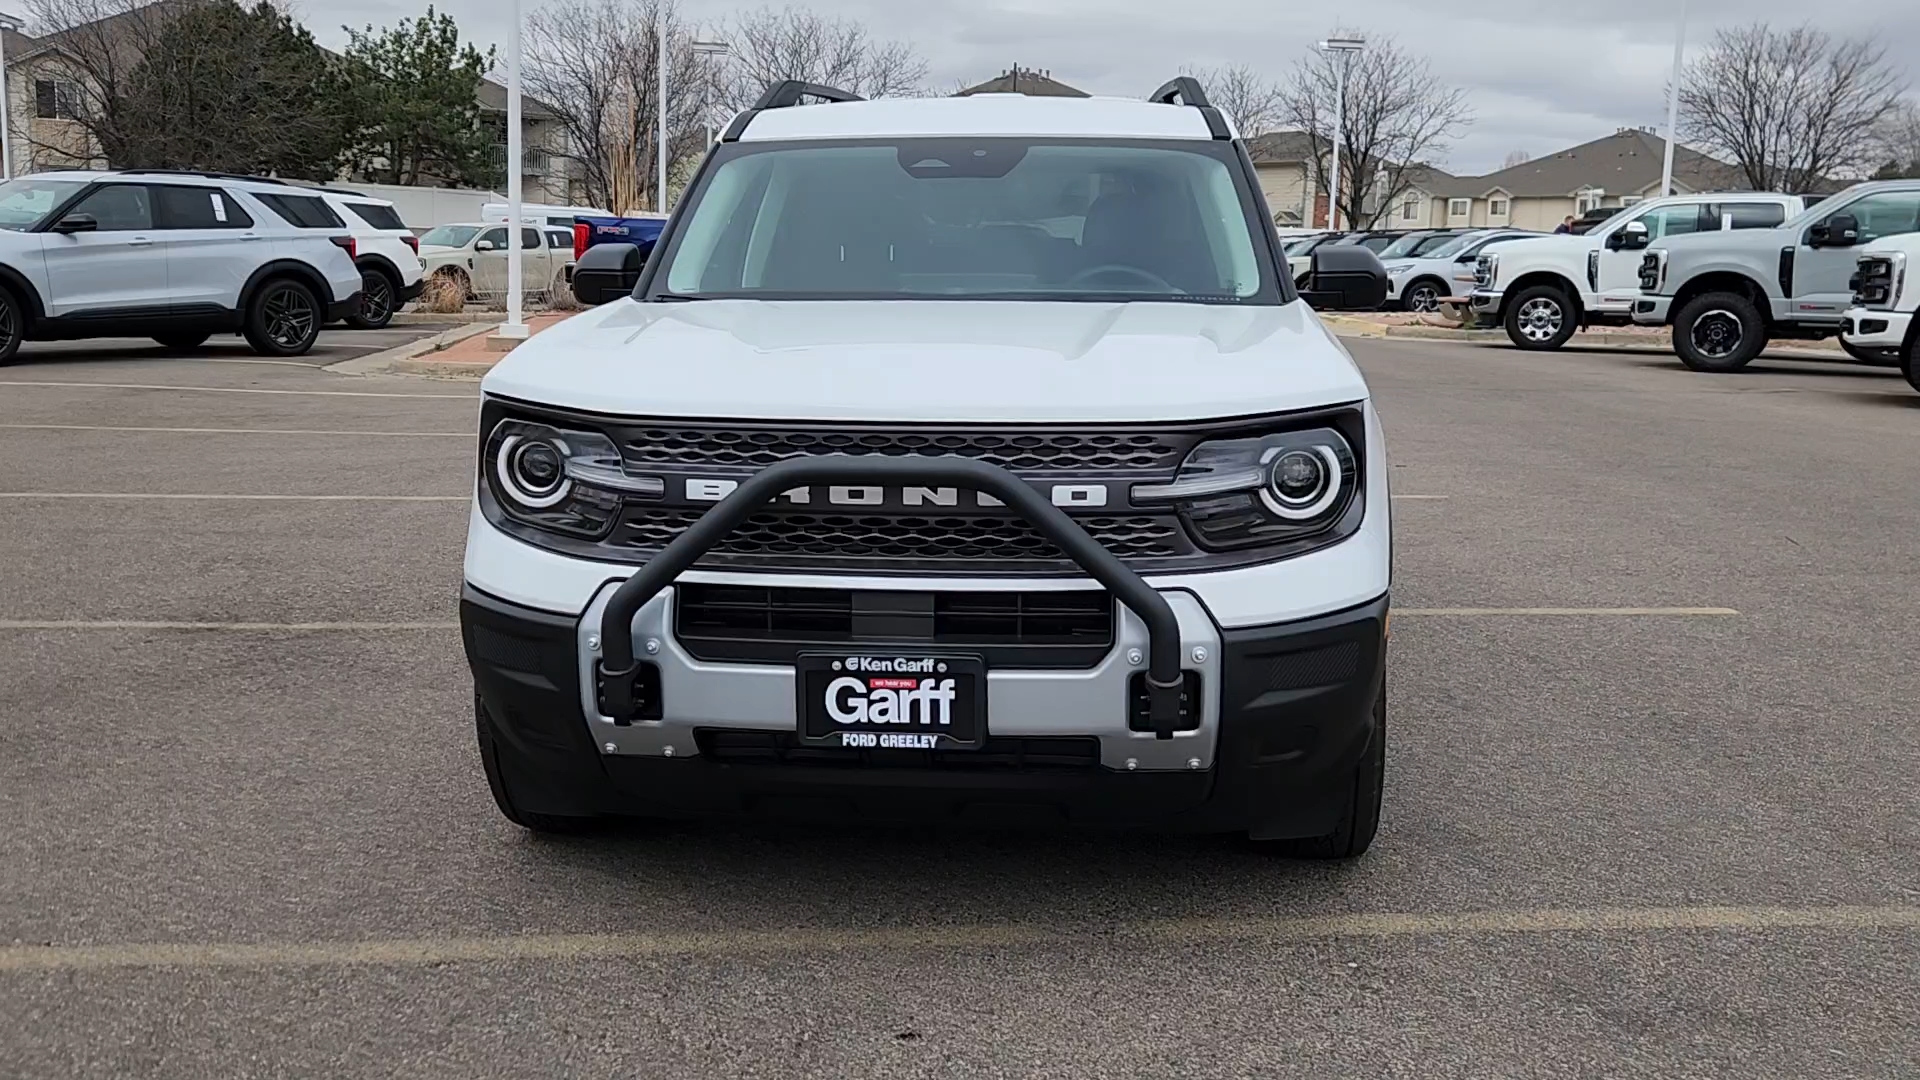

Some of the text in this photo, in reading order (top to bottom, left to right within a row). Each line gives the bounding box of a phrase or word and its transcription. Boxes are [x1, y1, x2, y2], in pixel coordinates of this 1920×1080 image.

[686, 478, 1107, 506] BONO
[860, 657, 893, 672] Ken
[893, 658, 935, 673] Garff
[825, 676, 955, 724] Garff
[842, 733, 938, 749] FORD GREELEY
